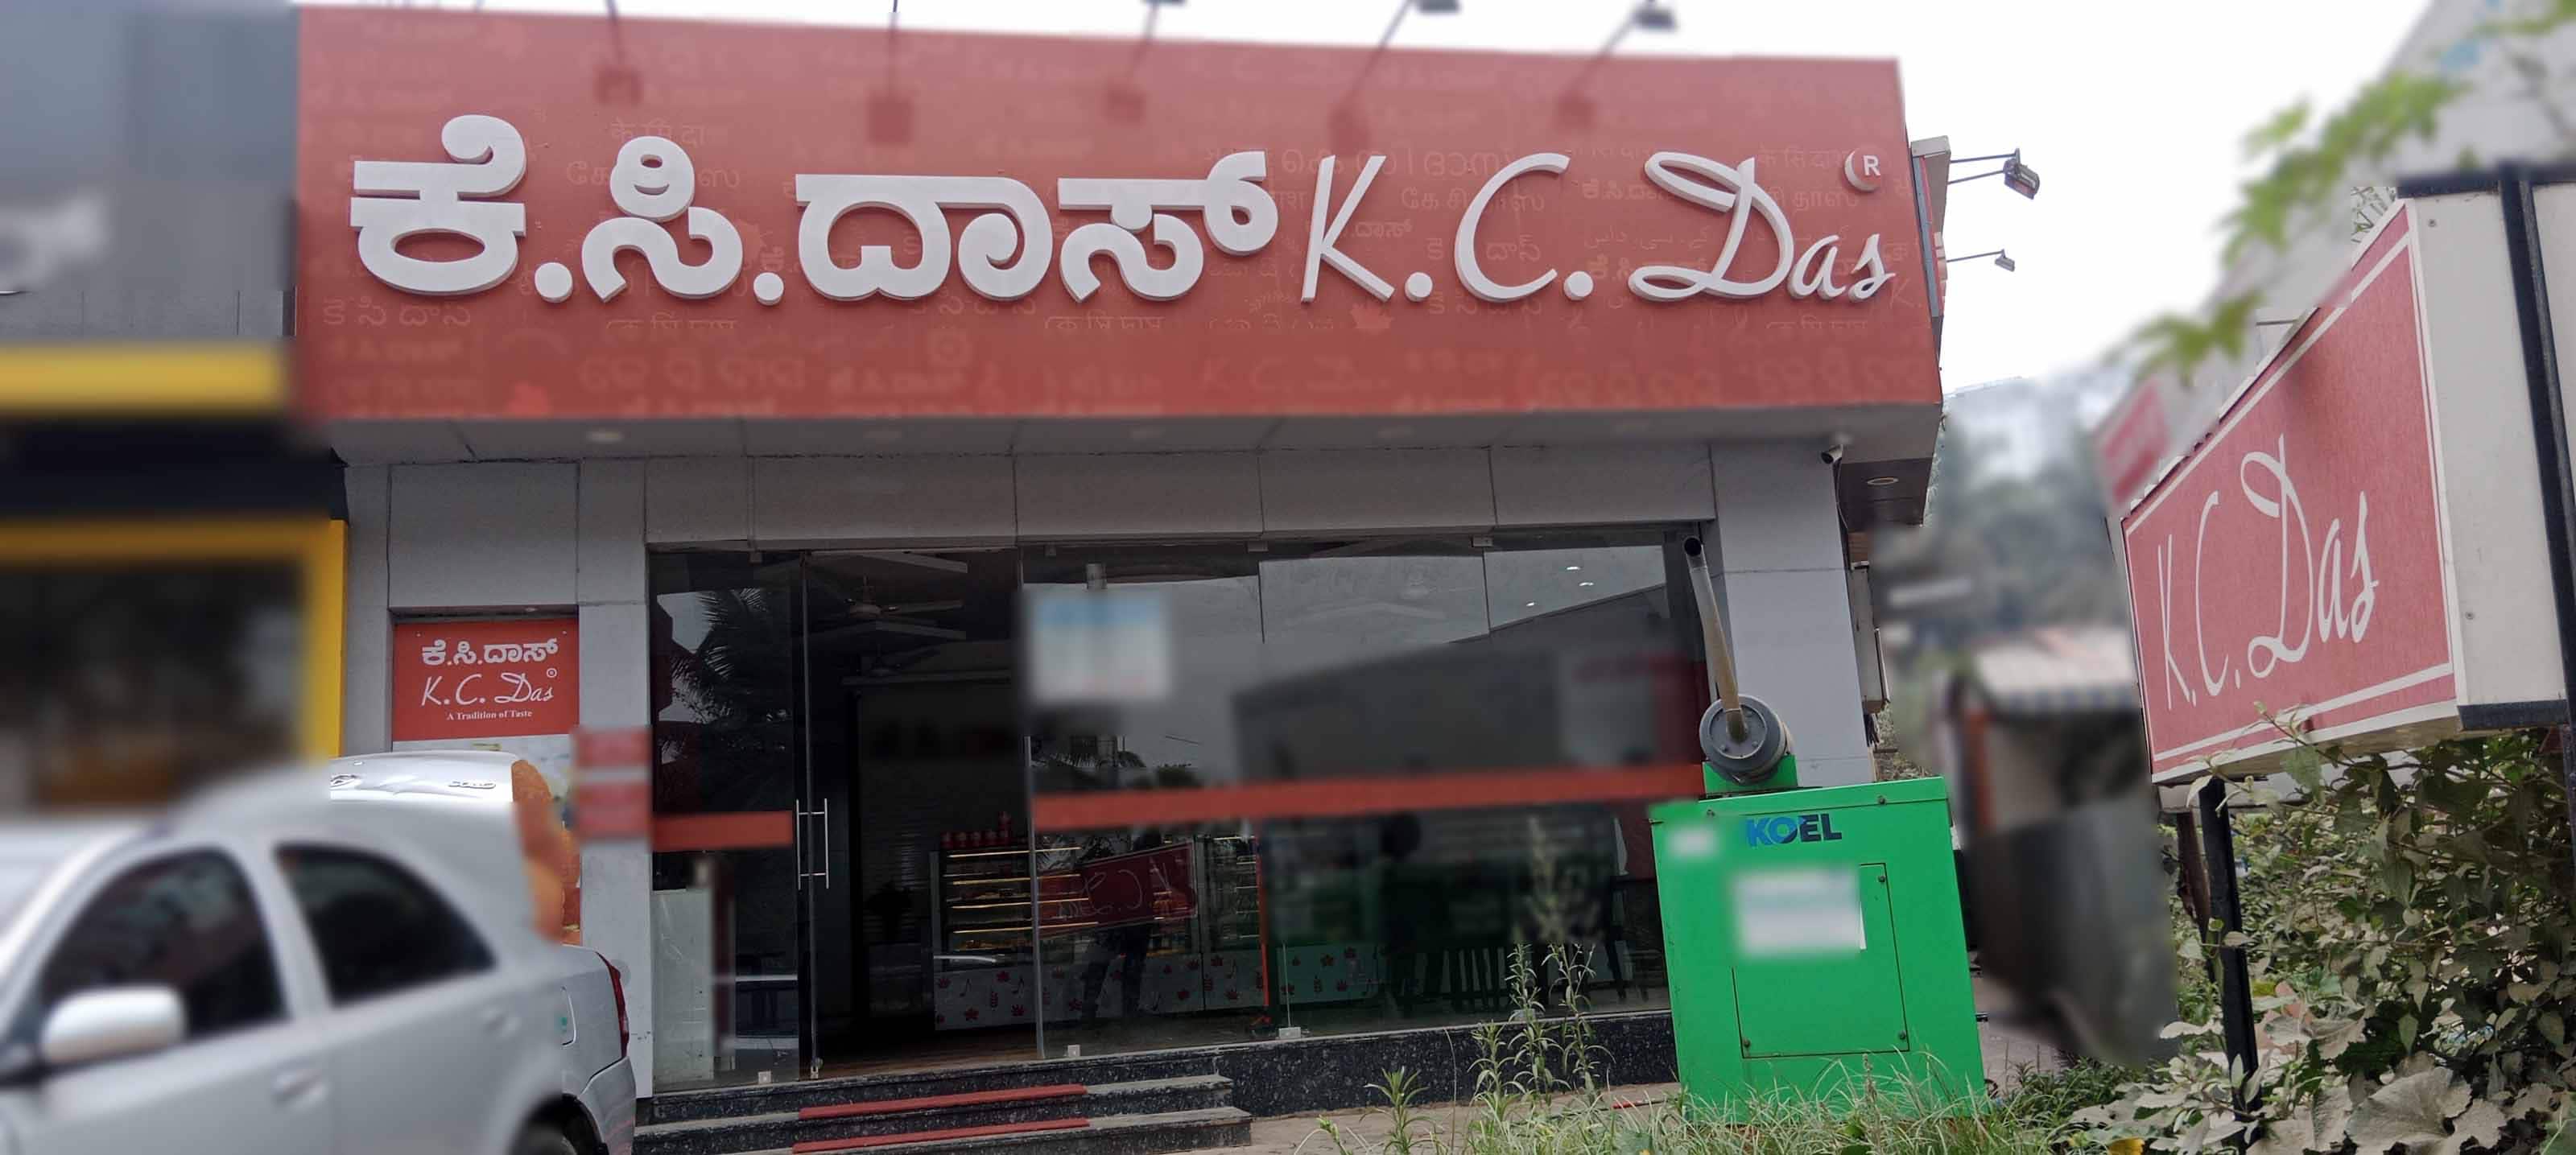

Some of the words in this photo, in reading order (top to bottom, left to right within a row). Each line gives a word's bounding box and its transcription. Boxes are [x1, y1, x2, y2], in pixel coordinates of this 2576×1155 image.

[349, 114, 1278, 303] ಕೆ.ಸಿ.ದಾಸ್
[1628, 151, 1895, 302] Das
[2240, 433, 2379, 678] Das
[421, 637, 559, 666] ಕೆ.ಸಿ.ದಾಸ್
[493, 671, 554, 703] Das
[447, 712, 455, 721] A
[456, 711, 497, 720] Tradition
[498, 709, 509, 719] of
[509, 708, 533, 719] Taste
[1746, 812, 1843, 848] KOEL
